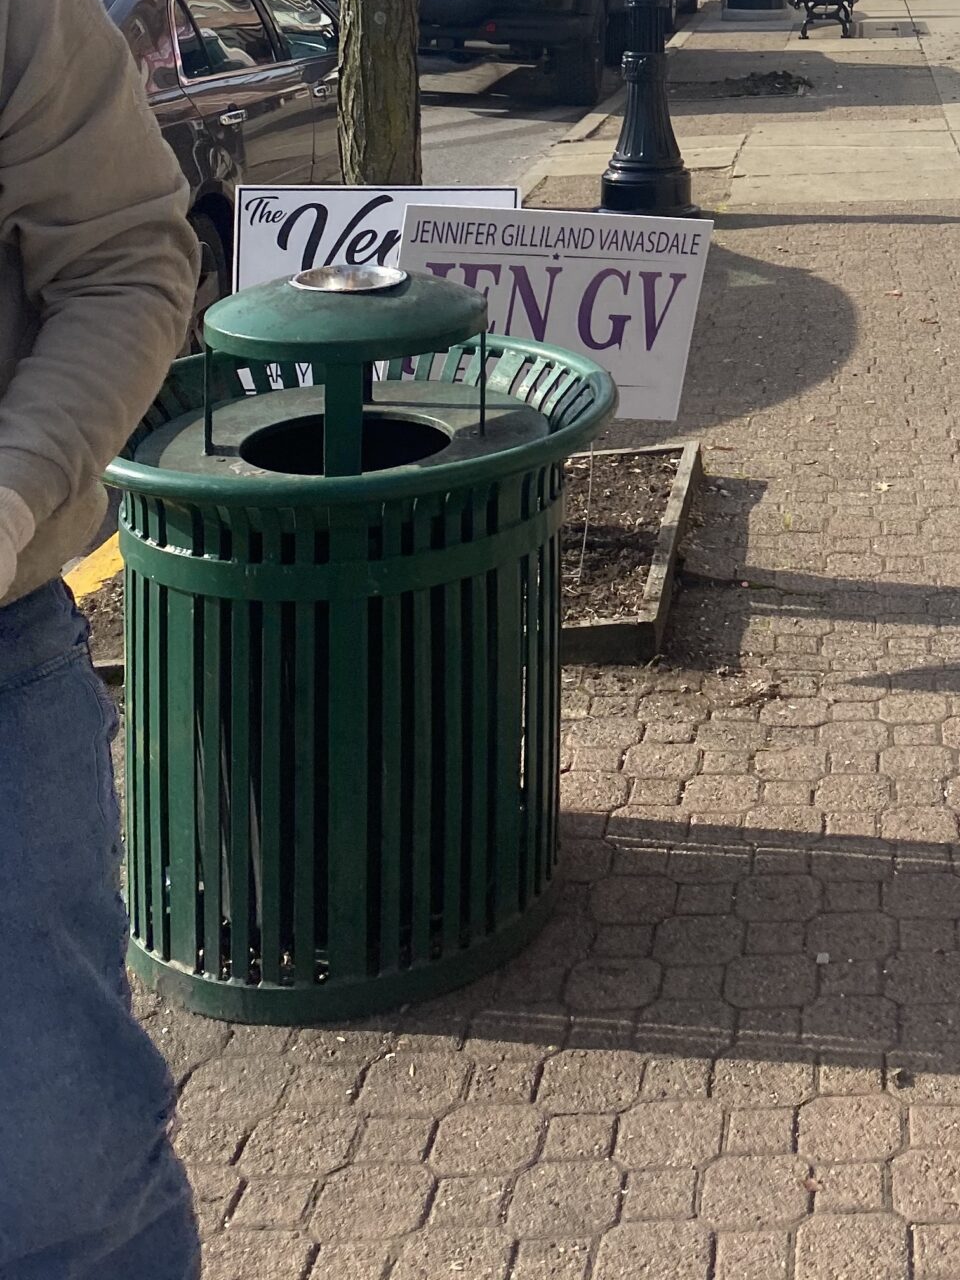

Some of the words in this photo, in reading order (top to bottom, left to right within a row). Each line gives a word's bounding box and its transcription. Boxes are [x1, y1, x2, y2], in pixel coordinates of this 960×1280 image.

[245, 196, 287, 226] The
[410, 220, 498, 246] JENNIFER
[501, 224, 595, 249] GILLILAND
[600, 228, 701, 256] VANASDALE
[418, 262, 563, 350] EN
[577, 266, 687, 351] GV
